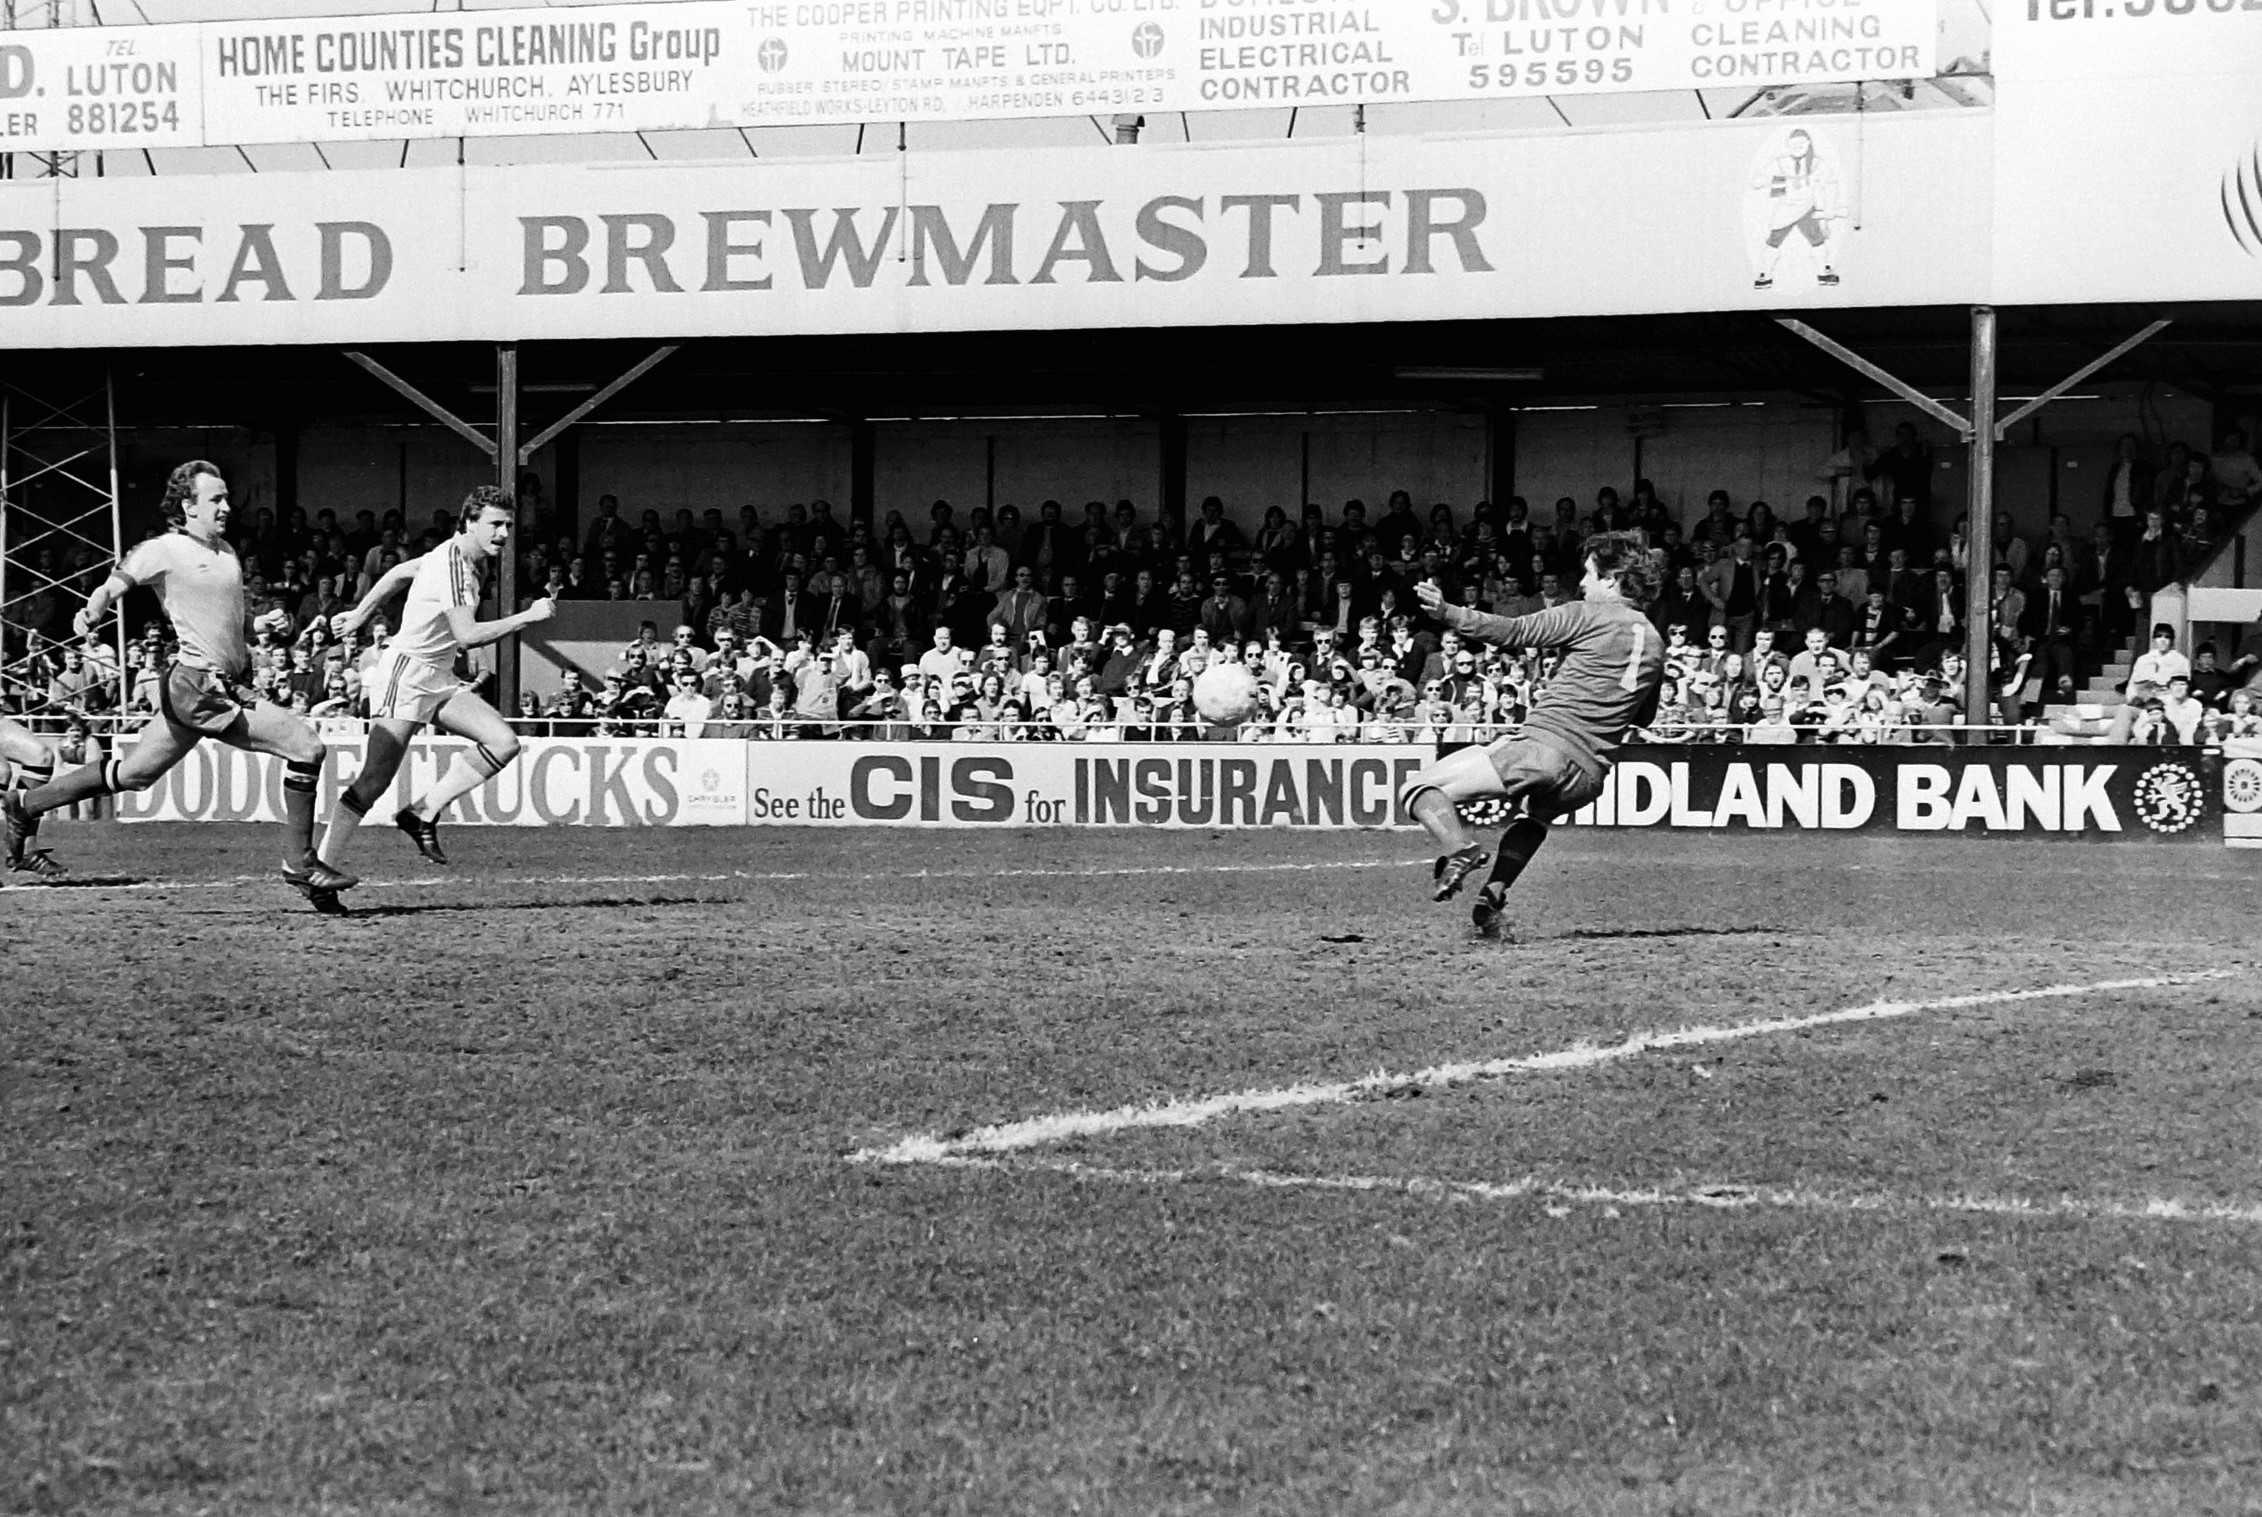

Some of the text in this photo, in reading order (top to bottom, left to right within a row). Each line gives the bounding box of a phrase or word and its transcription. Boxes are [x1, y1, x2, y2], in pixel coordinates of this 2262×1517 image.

[747, 5, 789, 27] THE
[796, 1, 888, 26] COOPER
[896, 0, 1009, 23] PRINTING
[1200, 10, 1380, 40] INDUSTRIAL
[839, 30, 913, 43] PRINTING
[924, 26, 994, 41] MACHINE
[1452, 25, 1644, 57] Tel LUTON
[1691, 15, 1881, 47] CLEANING
[219, 20, 720, 77] HOME COUNTIES CLEANING Group
[842, 42, 1077, 73] MOUNT TAPE LTD.
[1200, 41, 1393, 70] ELECTRICAL
[1691, 45, 1920, 78] CONTRACTOR
[67, 60, 177, 97] LUTON
[255, 84, 297, 106] THE
[567, 70, 693, 97] AYLESBURY
[756, 81, 814, 96] RUBBER
[1031, 69, 1097, 86] GENERAL
[1100, 68, 1177, 83] PRINTERS
[1201, 70, 1410, 101] CONTRACTOR
[1469, 57, 1634, 89] 595595
[327, 103, 625, 128] TELEPHONE WHITCHURCH 771
[968, 92, 1063, 110] HARPENDEN
[0, 112, 38, 136] ER
[67, 100, 179, 135] 881254
[517, 188, 1496, 293] BREWMASTER
[1617, 623, 1645, 692] 1
[754, 755, 1421, 826] See the CIS for INSURANCE
[1897, 764, 2122, 832] BANK
